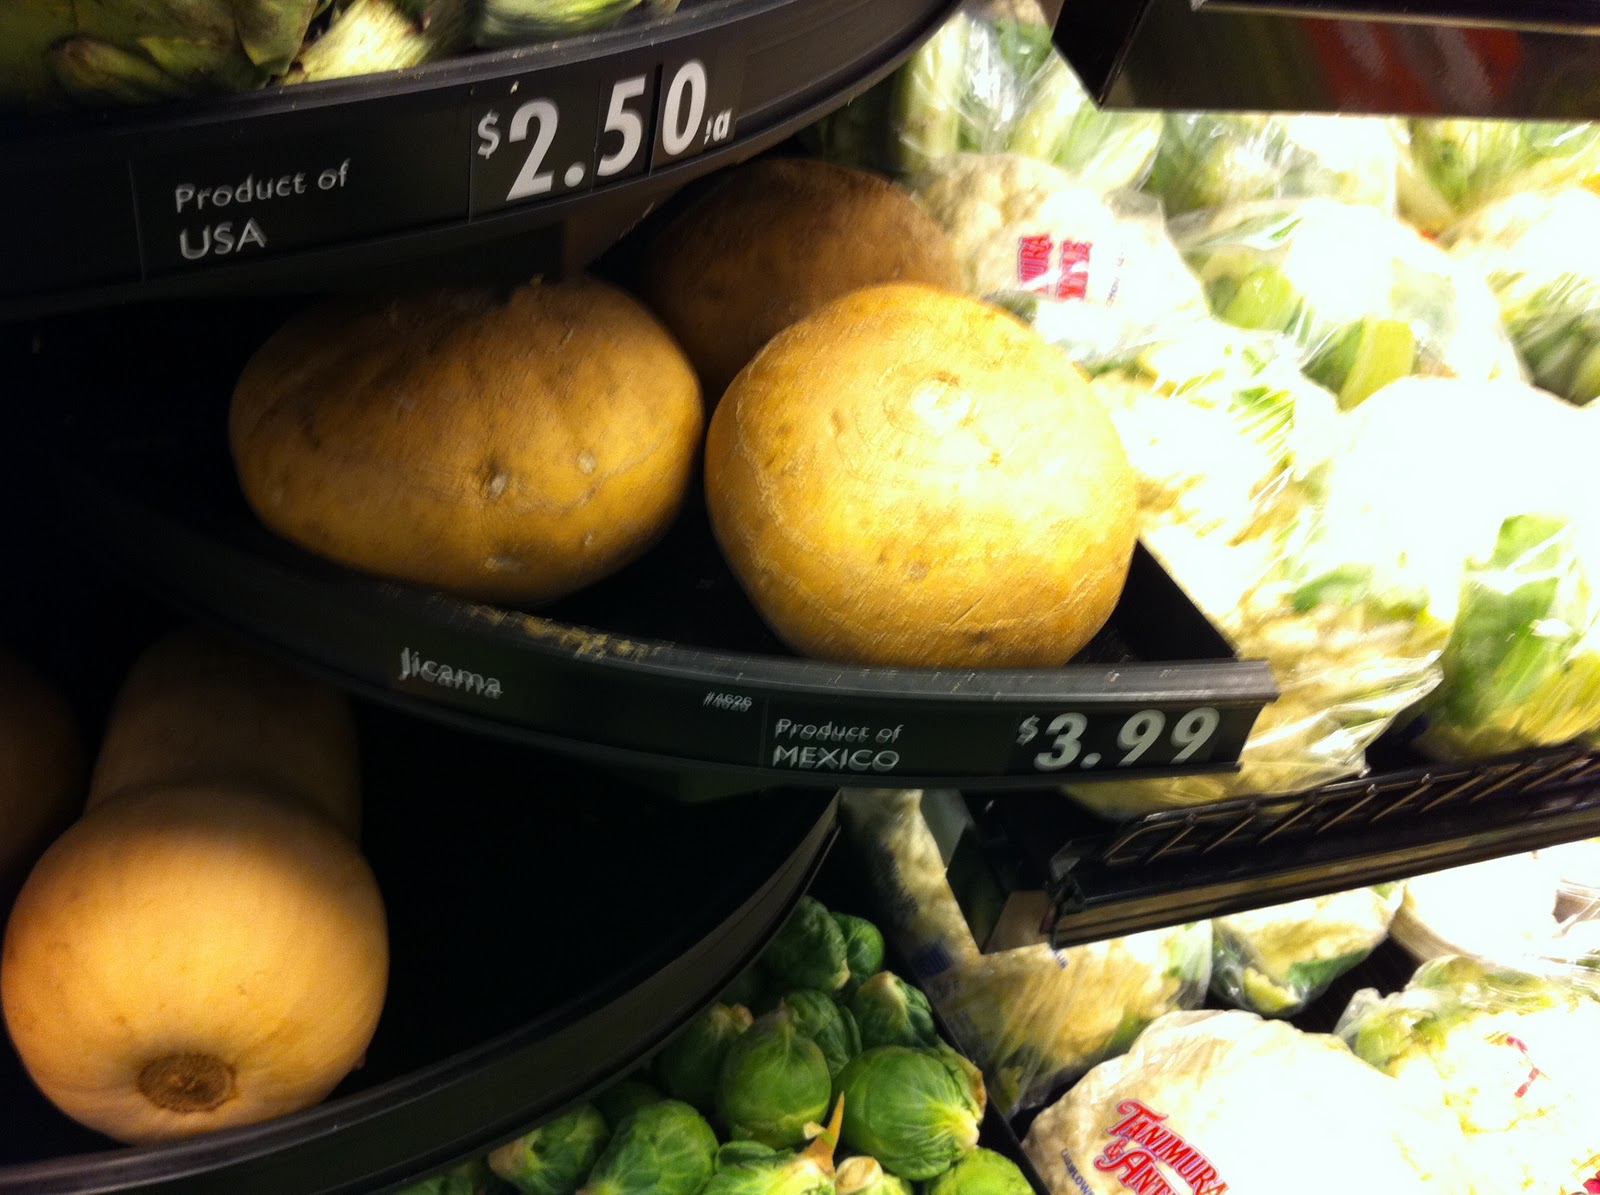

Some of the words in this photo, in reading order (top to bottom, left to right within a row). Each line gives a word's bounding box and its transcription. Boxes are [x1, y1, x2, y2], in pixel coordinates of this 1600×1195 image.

[476, 58, 708, 202] $2.50
[175, 172, 307, 214] Product
[317, 157, 351, 191] of
[179, 217, 269, 260] USA
[398, 646, 504, 700] Jicama
[774, 718, 870, 742] Product
[875, 724, 904, 744] of
[1015, 706, 1221, 772] $3.99
[772, 745, 900, 773] MEXICO
[1093, 1146, 1179, 1195] ANT
[1103, 1136, 1130, 1162] &
[1106, 1099, 1230, 1195] TANIMURA
